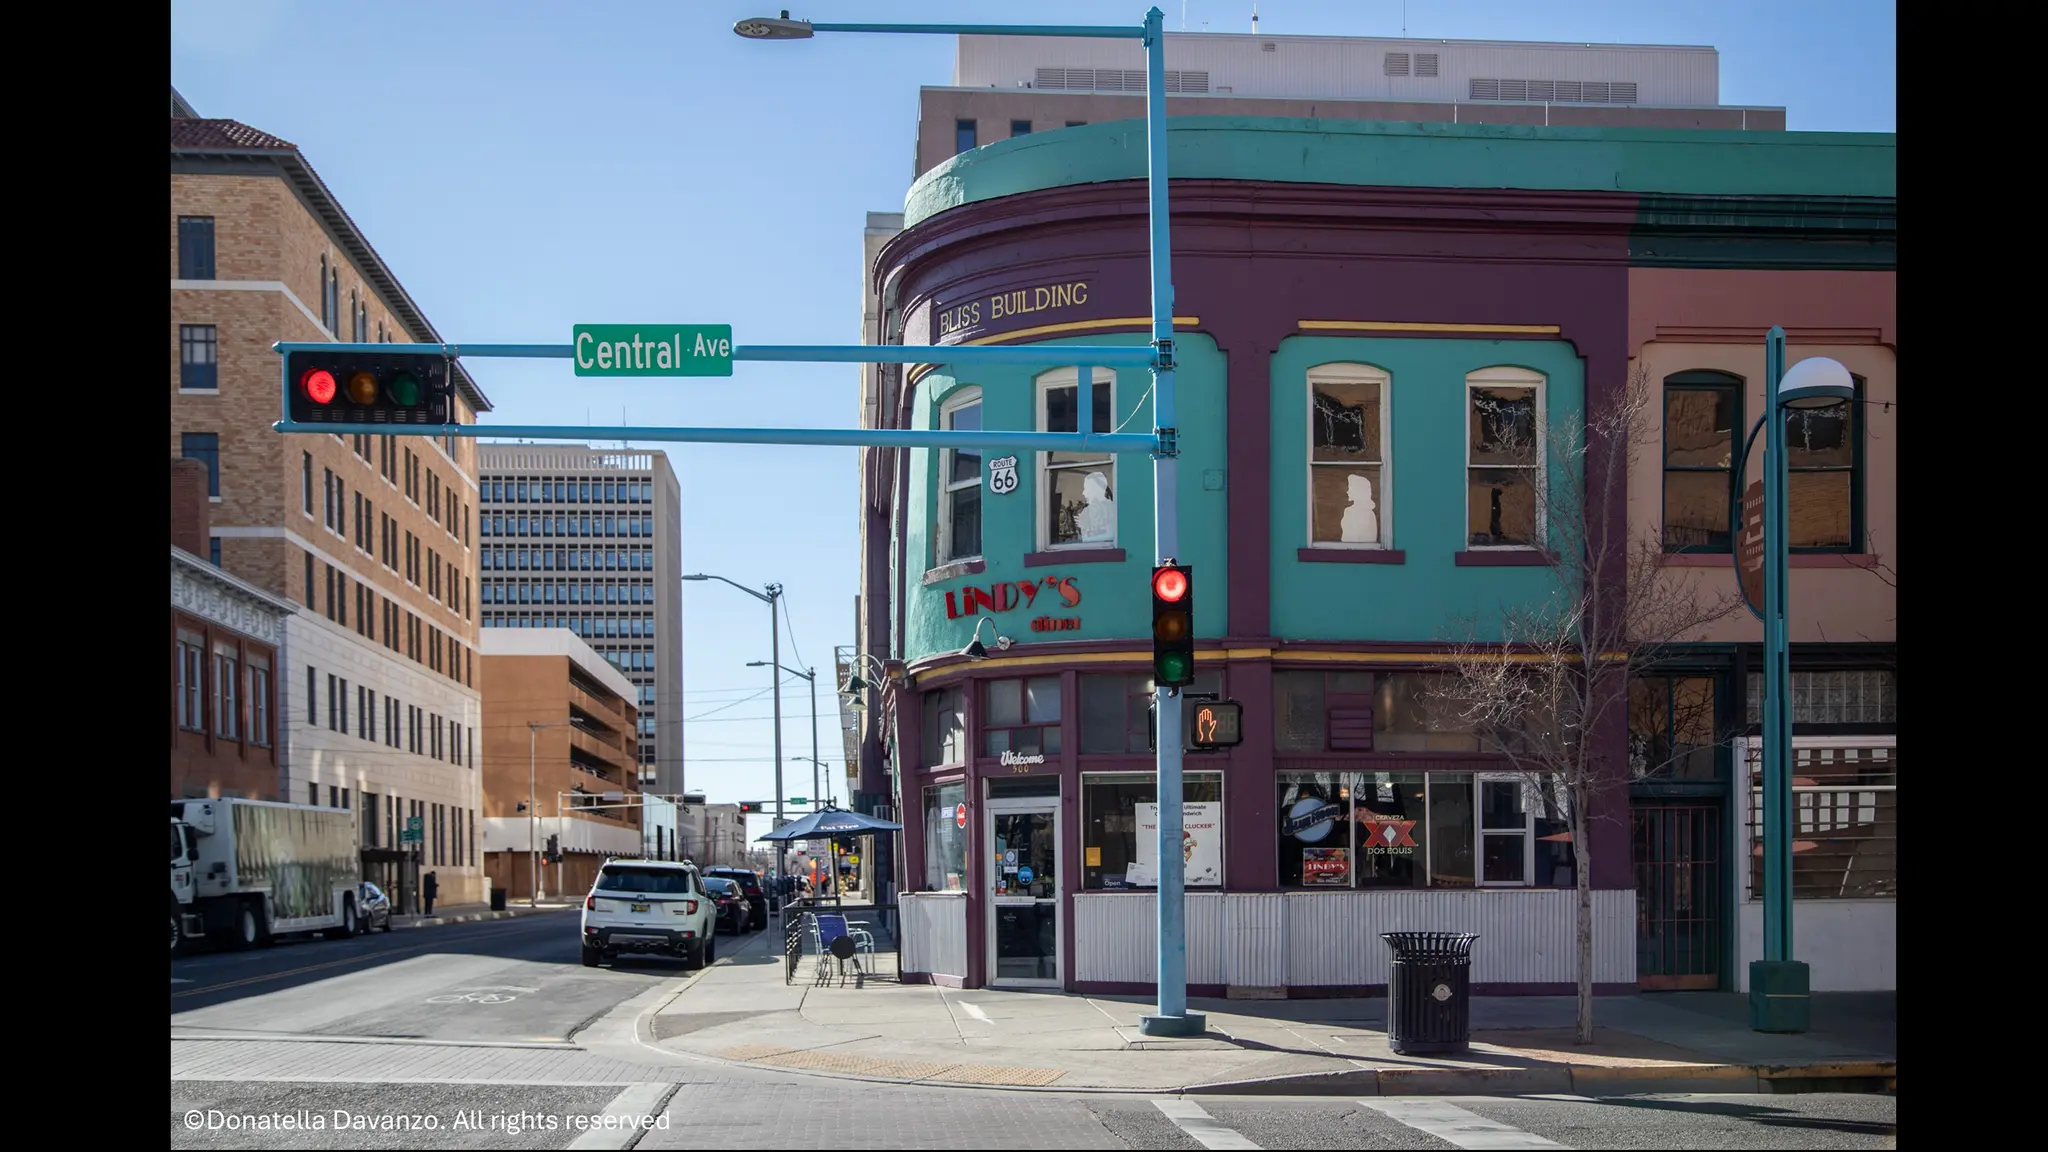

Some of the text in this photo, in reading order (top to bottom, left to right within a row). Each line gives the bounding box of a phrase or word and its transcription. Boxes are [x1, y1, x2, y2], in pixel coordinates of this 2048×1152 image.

[940, 283, 1088, 334] BLISS BUILDING
[577, 332, 730, 369] Central Ave
[993, 459, 1013, 467] ROUTE
[994, 470, 1014, 489] 66
[1031, 615, 1081, 632] diner
[1001, 750, 1044, 766] Welcome
[1013, 765, 1029, 773] 500
